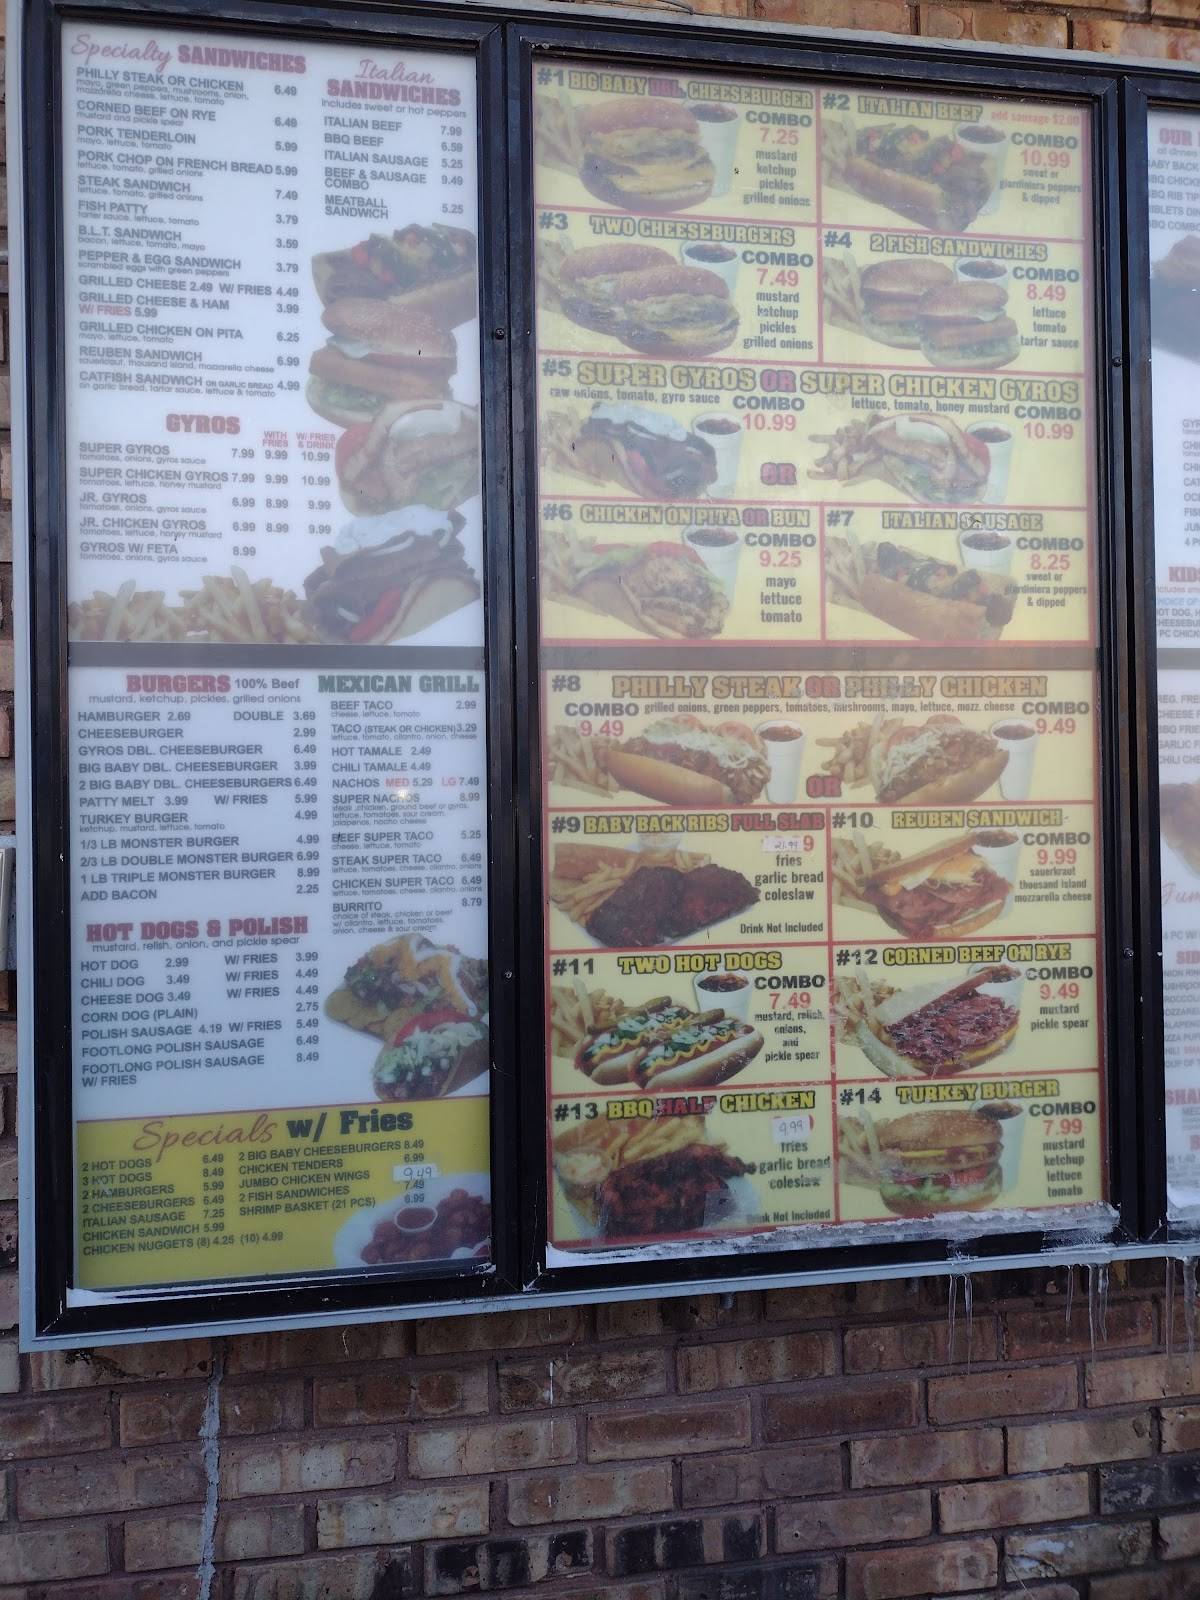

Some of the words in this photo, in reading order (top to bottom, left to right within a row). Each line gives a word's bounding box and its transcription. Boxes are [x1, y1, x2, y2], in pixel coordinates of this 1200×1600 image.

[71, 33, 172, 72] Specialty
[178, 44, 306, 73] SANDWICHES
[76, 67, 119, 81] PHILLY
[123, 71, 163, 85] STEAK
[167, 75, 185, 86] OR
[189, 76, 244, 91] CHICKEN
[355, 60, 435, 82] Italian
[327, 79, 460, 105] SANDWICHES
[537, 67, 564, 86] #1
[568, 70, 599, 90] BIG
[600, 72, 646, 94] BABY
[687, 80, 814, 108] CHEESEBURGER
[823, 92, 850, 110] #2
[858, 96, 933, 118] ITALIAN
[936, 101, 983, 122] BEEF
[324, 116, 368, 129] ITALIAN
[371, 120, 402, 132] BEEF
[745, 110, 812, 128] COMBO
[760, 128, 799, 146] 7.25
[1011, 131, 1079, 149] COMBO
[1020, 150, 1070, 168] 10.99
[538, 212, 568, 230] #3
[589, 214, 636, 236] TWO
[638, 217, 795, 246] CHEESEBURGERS
[824, 231, 852, 248] #4
[870, 234, 885, 252] 2
[887, 235, 929, 255] FISH
[932, 237, 1048, 262] SANDWICHES
[741, 250, 813, 267] COMBO
[757, 268, 799, 286] 7.49
[1012, 266, 1079, 282] COMBO
[756, 291, 799, 303] mustard
[1026, 284, 1067, 301] 8.49
[743, 337, 777, 350] grilled
[542, 359, 571, 377] #5
[577, 361, 667, 388] SUPER
[670, 365, 756, 392] GYROS
[760, 369, 797, 393] OR
[799, 370, 885, 397] SUPER
[889, 374, 996, 400] CHICKEN
[999, 379, 1080, 404] GYROS
[733, 396, 805, 412] COMBO
[1014, 405, 1081, 420] COMBO
[166, 414, 241, 434] GYROS
[742, 413, 797, 431] 10.99
[1024, 423, 1074, 440] 10.99
[79, 442, 122, 454] SUPER
[125, 444, 170, 455] GYROS
[231, 448, 255, 459] 7.99
[760, 462, 797, 485] OR
[543, 504, 572, 521] #6
[580, 504, 663, 525] CHICKEN
[665, 506, 692, 526] ON
[694, 507, 741, 526] PITA
[742, 508, 769, 527] OR
[771, 509, 810, 528] BUN
[827, 510, 854, 527] #7
[882, 511, 958, 529] ITALIAN
[959, 512, 1043, 531] SAUSAGE
[745, 533, 817, 547] COMBO
[1016, 536, 1084, 551] COMBO
[759, 550, 801, 567] 9.25
[1030, 554, 1071, 570] 8.25
[760, 593, 802, 605] lettuce
[761, 610, 803, 623] tomato
[126, 674, 232, 693] BURGERS
[235, 678, 268, 689] 100%
[271, 678, 300, 689] Beef
[318, 675, 412, 693] MEXICAN
[419, 675, 480, 693] GRILL
[551, 675, 581, 692] #8
[612, 675, 708, 698] PHILLY
[712, 675, 802, 698] STEAK
[805, 676, 841, 698] OR
[845, 676, 937, 698] PHILLY
[941, 676, 1048, 698] CHICKEN
[565, 702, 639, 717] COMBO
[1022, 701, 1090, 715] COMBO
[78, 728, 184, 739] CHEESEBURGER
[580, 720, 624, 737] 9.49
[1035, 718, 1076, 735] 9.49
[332, 746, 355, 757] HOT
[358, 746, 402, 757] TAMALE
[410, 746, 431, 756] 2.49
[806, 774, 842, 798] OR
[551, 816, 581, 834] #9
[583, 815, 635, 834] BABY
[636, 814, 686, 833] BACK
[686, 814, 729, 833] RIBS
[731, 813, 775, 832] FULL
[777, 812, 825, 831] SLAB
[832, 812, 873, 828] #10
[892, 811, 965, 829] REUBEN
[967, 808, 1063, 827] SANDWICH
[80, 839, 97, 850] 1/3
[101, 839, 118, 850] LB
[120, 837, 183, 850] MONSTER
[186, 836, 240, 848] BURGER
[296, 834, 319, 845] 4.99
[1023, 832, 1091, 846] COMBO
[1036, 848, 1077, 865] 9.99
[754, 872, 789, 886] garlic
[791, 871, 824, 883] bread
[764, 889, 814, 901] coleslaw
[86, 923, 134, 942] HOT
[140, 921, 199, 940] DOGS
[206, 919, 221, 938] &
[229, 916, 308, 937] POLISH
[883, 946, 956, 966] CORNED
[958, 944, 1005, 963] BEEF
[1007, 944, 1033, 961] ON
[1035, 943, 1071, 961] RYE
[552, 958, 595, 976] #11
[618, 955, 670, 974] TWO
[675, 953, 720, 973] HOT
[724, 951, 782, 971] DOGS
[754, 974, 825, 989] COMBO
[1026, 966, 1092, 980] COMBO
[1039, 983, 1079, 999] 9.49
[768, 991, 812, 1009] 7.49
[81, 1012, 119, 1024] CORN
[121, 1011, 150, 1022] DOG
[153, 1008, 198, 1023] (PLAIN)
[839, 1088, 881, 1105] #14
[896, 1082, 978, 1104] TURKEY
[980, 1079, 1060, 1101] BURGER
[555, 1103, 598, 1121] #13
[607, 1099, 654, 1118] BBQ
[720, 1090, 816, 1113] CHICKEN
[1029, 1101, 1096, 1116] COMBO
[1043, 1119, 1083, 1136] 7.99
[132, 1113, 278, 1163] Specials
[287, 1113, 327, 1142] w/
[340, 1110, 413, 1135] Fries
[91, 1160, 116, 1171] HOT
[119, 1158, 152, 1169] DOGS
[1044, 1154, 1085, 1167] ketchup
